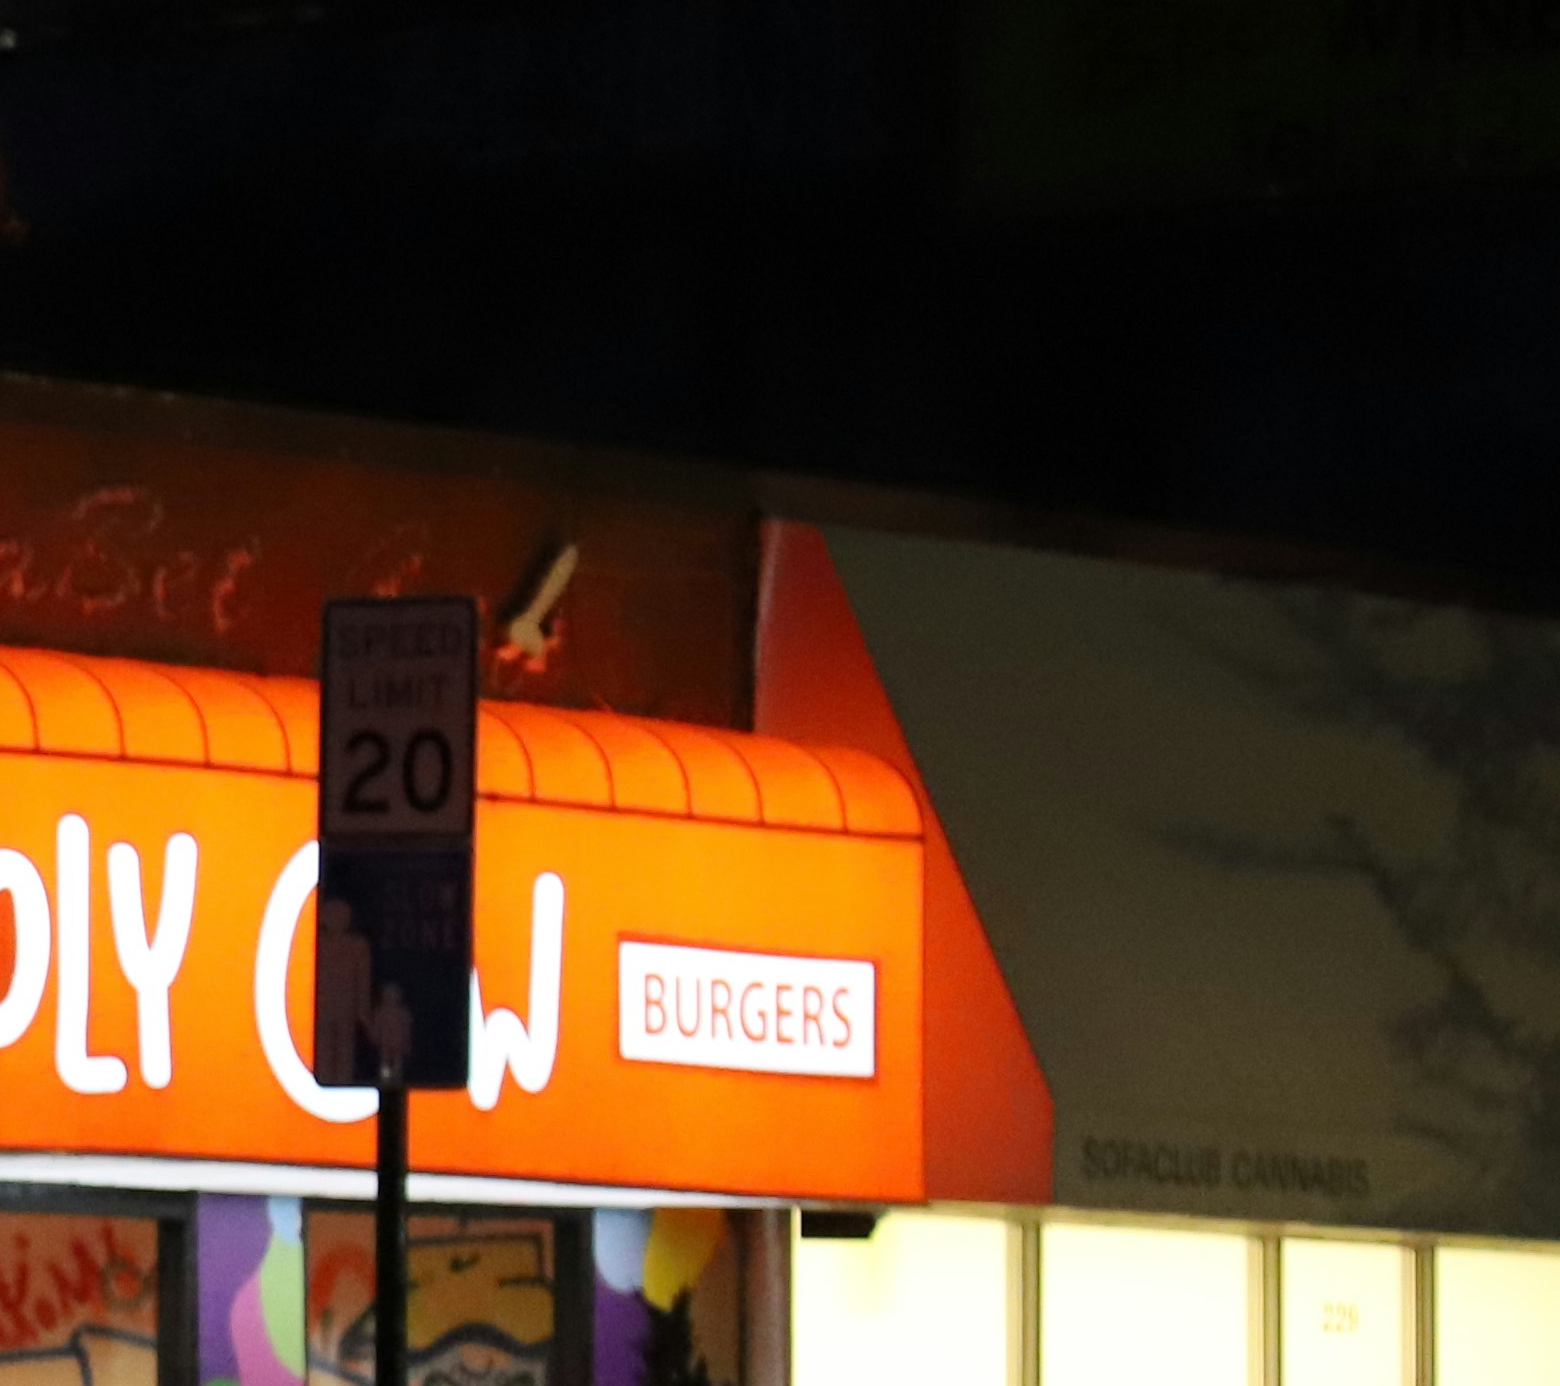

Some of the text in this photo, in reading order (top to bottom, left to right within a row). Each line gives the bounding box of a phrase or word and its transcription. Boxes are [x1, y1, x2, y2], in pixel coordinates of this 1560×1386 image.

[337, 622, 461, 658] SPEED
[349, 671, 447, 711] LIMIT
[342, 729, 452, 814] 20
[254, 837, 565, 1123] CW
[644, 973, 852, 1048] BURGERS
[1080, 1134, 1370, 1199] SOFACLUB CANNABIS
